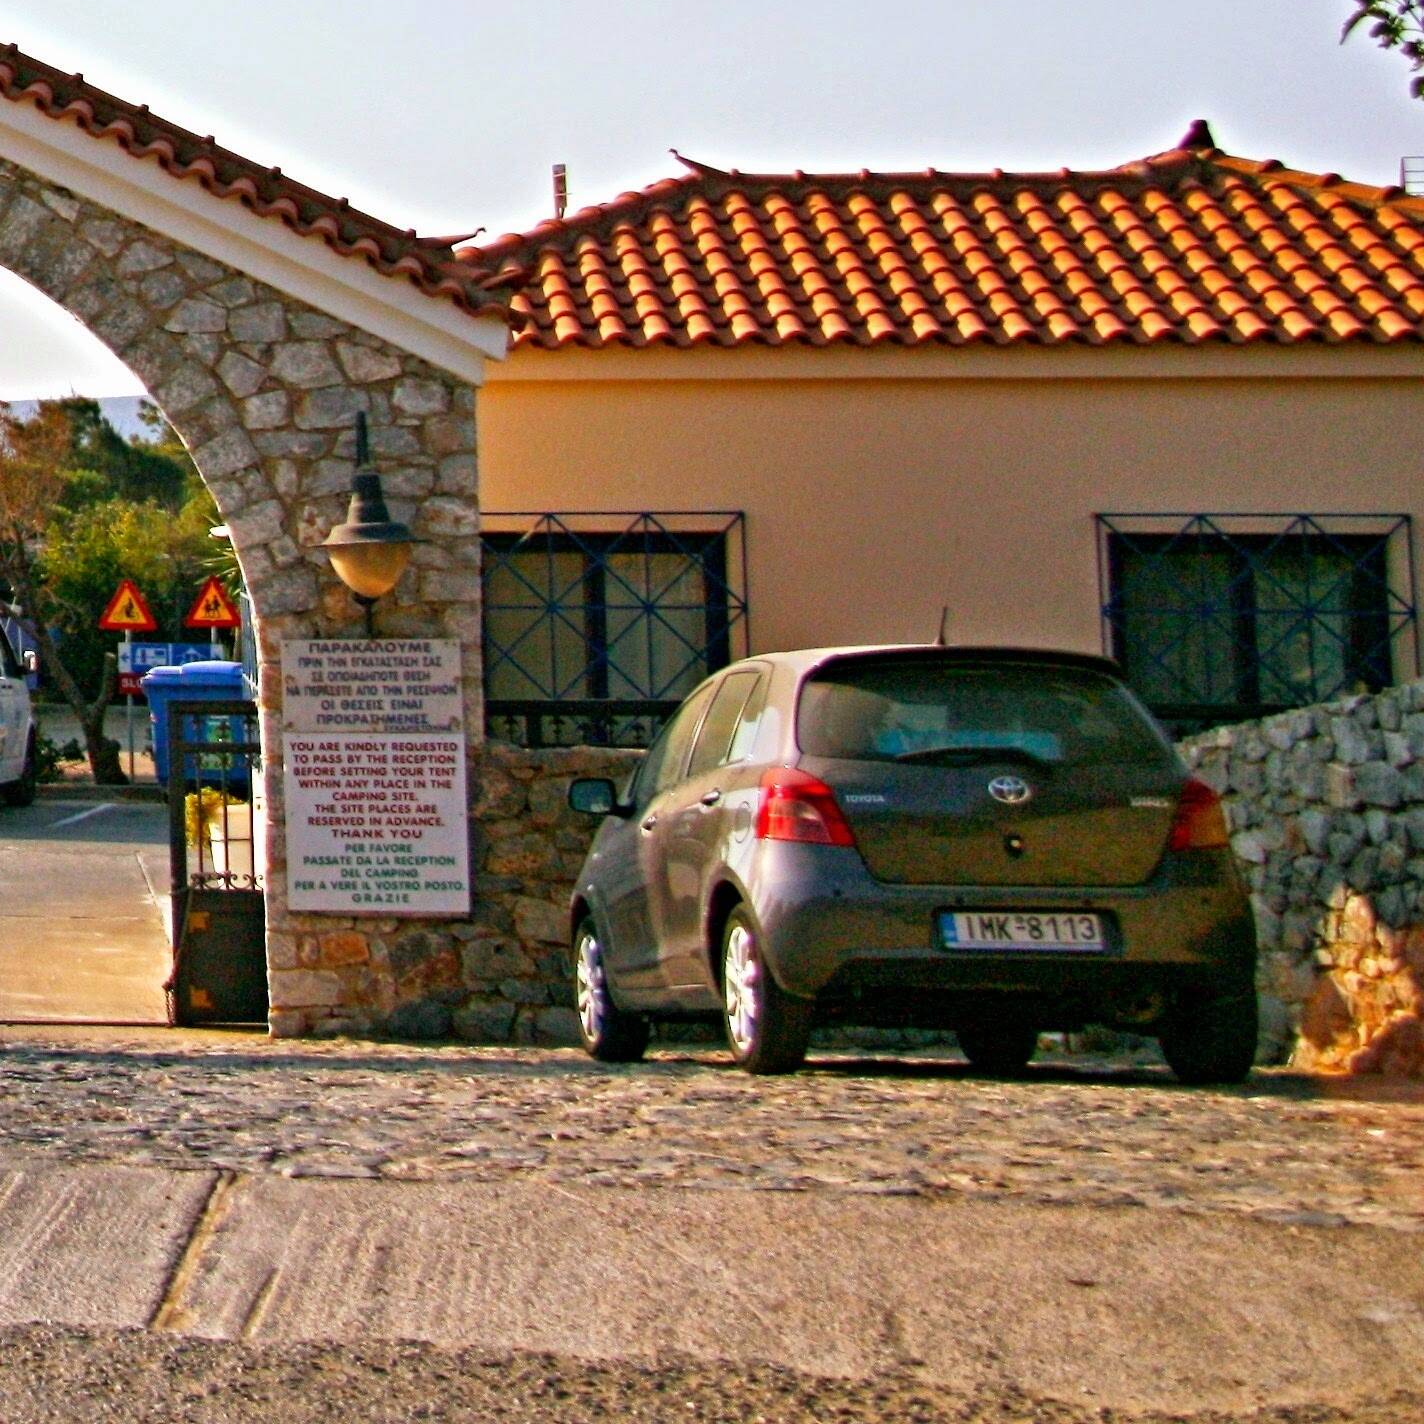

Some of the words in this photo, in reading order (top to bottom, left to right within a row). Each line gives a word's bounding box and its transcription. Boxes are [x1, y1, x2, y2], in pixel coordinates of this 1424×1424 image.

[309, 642, 431, 653] ΠΑΡΑΚΑΛΟΥΜΕ
[327, 657, 346, 666] ΤΗΝ
[422, 656, 442, 666] ΣΑΣ
[341, 700, 384, 710] ΘΕΣΕΙΣ
[390, 700, 423, 709] ΕΙΝΑΙ
[290, 742, 314, 751] YOU
[319, 742, 340, 751] ARE
[345, 742, 386, 751] KINDLY
[391, 742, 458, 751] REQUESTED
[293, 755, 308, 763] TO
[313, 755, 342, 763] PASS
[347, 755, 362, 763] BY
[368, 755, 387, 763] THE
[392, 755, 455, 763] RECEPTION
[293, 767, 335, 776] BEFORE
[341, 767, 387, 776] SETTING
[392, 767, 423, 776] YOUR
[429, 767, 456, 776] TENT
[298, 780, 340, 788] WITHIN
[345, 780, 369, 788] ANY
[374, 780, 409, 788] PLACE
[413, 780, 426, 788] IN
[431, 780, 452, 788] THE
[332, 792, 387, 801] CAMPING
[391, 792, 418, 801] SITE.
[845, 795, 884, 803] TOYOTA
[315, 804, 336, 813] THE
[341, 804, 363, 813] SITE
[368, 804, 411, 813] PLACES
[416, 804, 437, 813] ARE
[308, 817, 364, 825] RESERVED
[369, 817, 381, 825] IN
[386, 817, 445, 826] ADVANCE.
[332, 829, 383, 838] THANK
[390, 829, 422, 838] YOU
[345, 844, 364, 852] PER
[370, 844, 412, 852] FAVORE
[303, 856, 351, 865] PASSATE
[356, 856, 372, 865] DA
[376, 856, 390, 865] LA
[394, 856, 455, 865] RECEPTION
[341, 869, 361, 877] DEL
[365, 869, 418, 877] CAMPING
[294, 881, 314, 890] PER
[319, 881, 327, 890] A
[332, 881, 357, 890] VERE
[362, 881, 371, 890] IL
[376, 881, 420, 890] VOSTRO
[352, 893, 409, 903] GRAZIE
